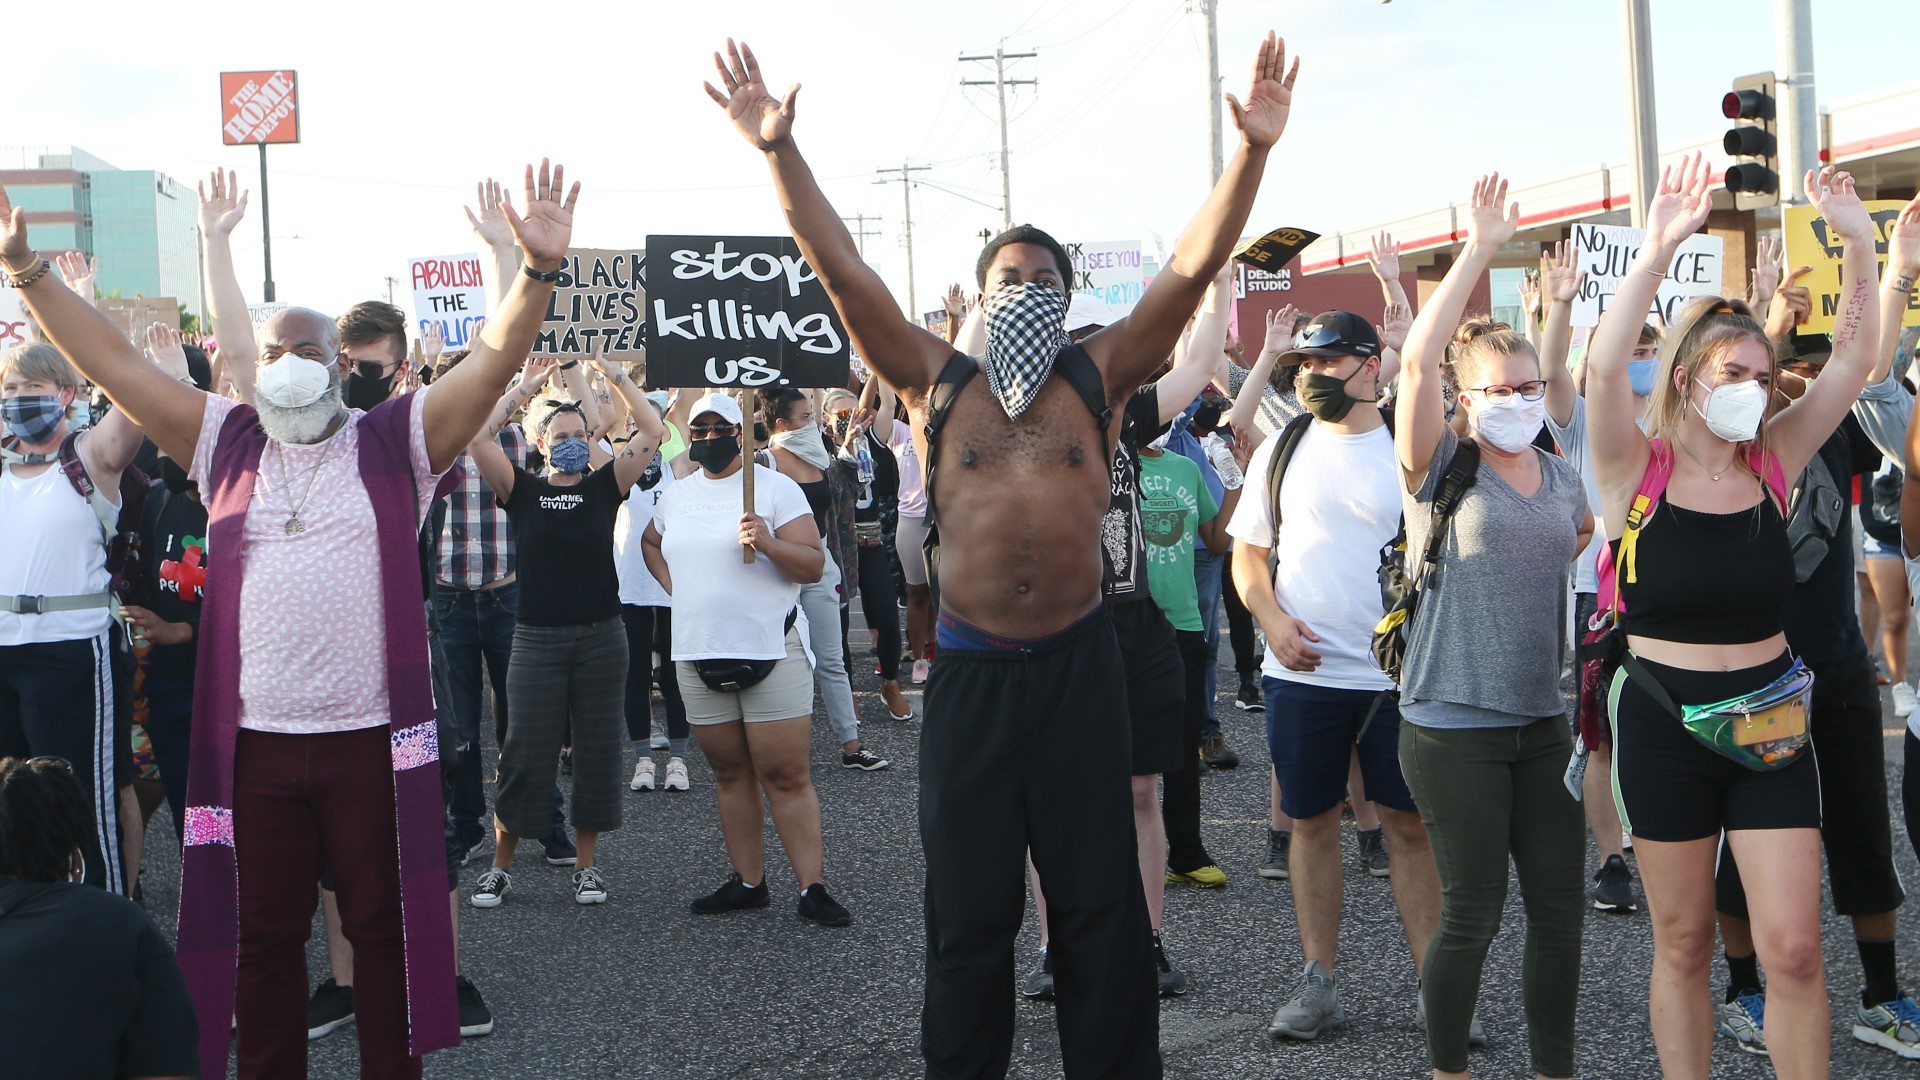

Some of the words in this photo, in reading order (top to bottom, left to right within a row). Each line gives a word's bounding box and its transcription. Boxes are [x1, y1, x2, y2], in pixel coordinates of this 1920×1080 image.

[224, 71, 295, 144] HOME
[230, 80, 260, 108] THE
[252, 96, 295, 143] DEPOT
[1576, 225, 1606, 253] No
[412, 259, 484, 290] ABOLISH
[553, 252, 646, 293] BLACK
[670, 241, 818, 297] stop
[1088, 252, 1114, 270] SEE
[1115, 250, 1141, 268] YOU
[1248, 280, 1291, 291] STUDIO
[428, 293, 468, 313] THE
[543, 290, 640, 324] LIVES
[531, 322, 646, 355] MATTER
[653, 299, 843, 355] killing
[704, 356, 790, 386] us.
[541, 501, 579, 510] CIVILIA
[166, 534, 173, 552] I
[1146, 531, 1193, 565] RESTS
